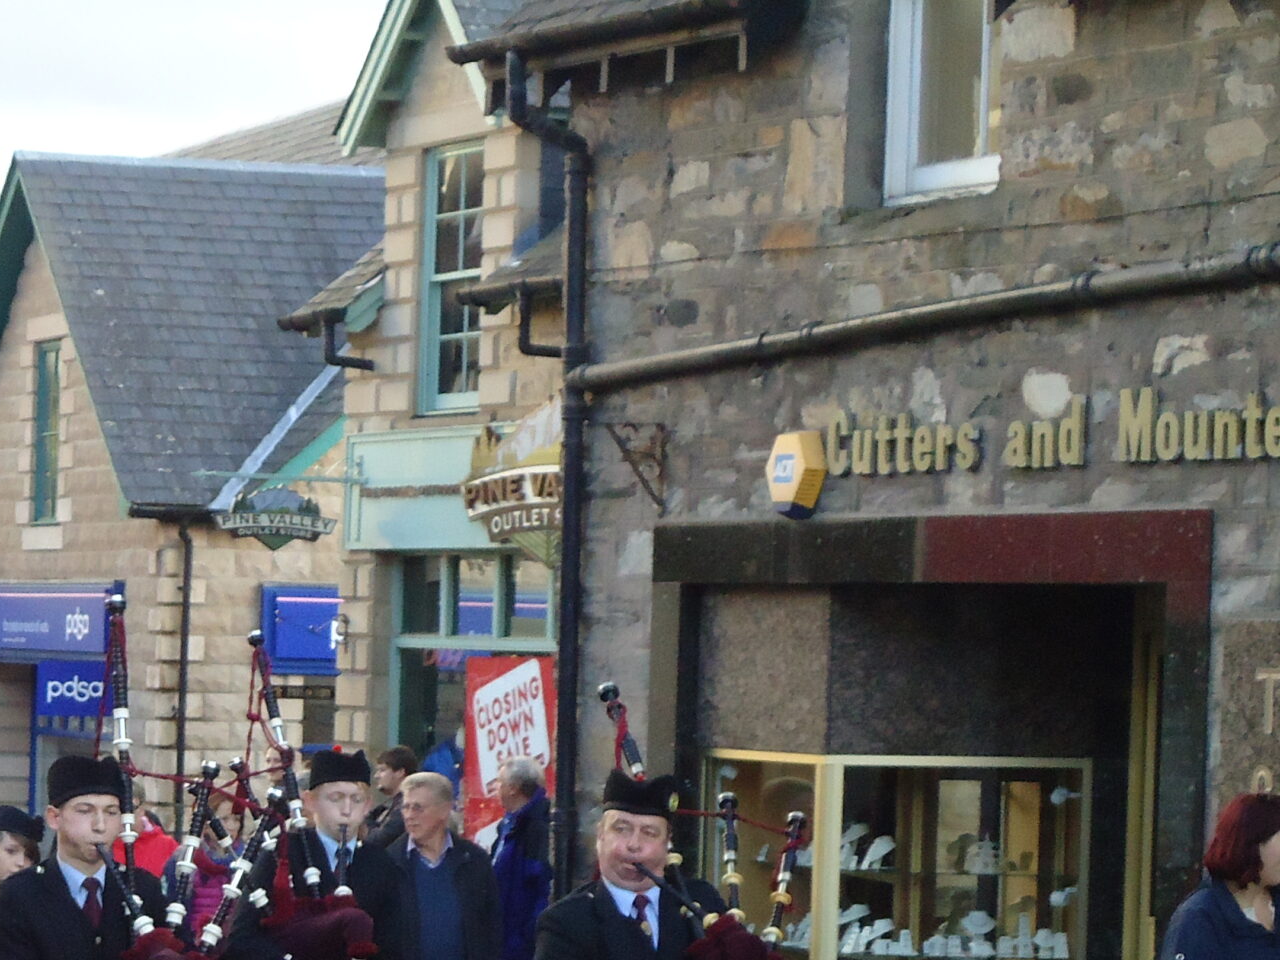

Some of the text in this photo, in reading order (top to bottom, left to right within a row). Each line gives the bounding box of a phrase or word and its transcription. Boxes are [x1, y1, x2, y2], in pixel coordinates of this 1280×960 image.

[826, 409, 980, 477] Cutters
[1002, 393, 1087, 468] and
[465, 473, 525, 509] PINE
[222, 513, 332, 531] PINE VALLEY
[237, 527, 277, 536] OUTLET
[490, 507, 551, 533] OUTLET
[65, 606, 90, 641] pdsa
[47, 675, 104, 704] pdsa
[476, 676, 541, 729] CLOSING
[487, 706, 535, 751] DOWN
